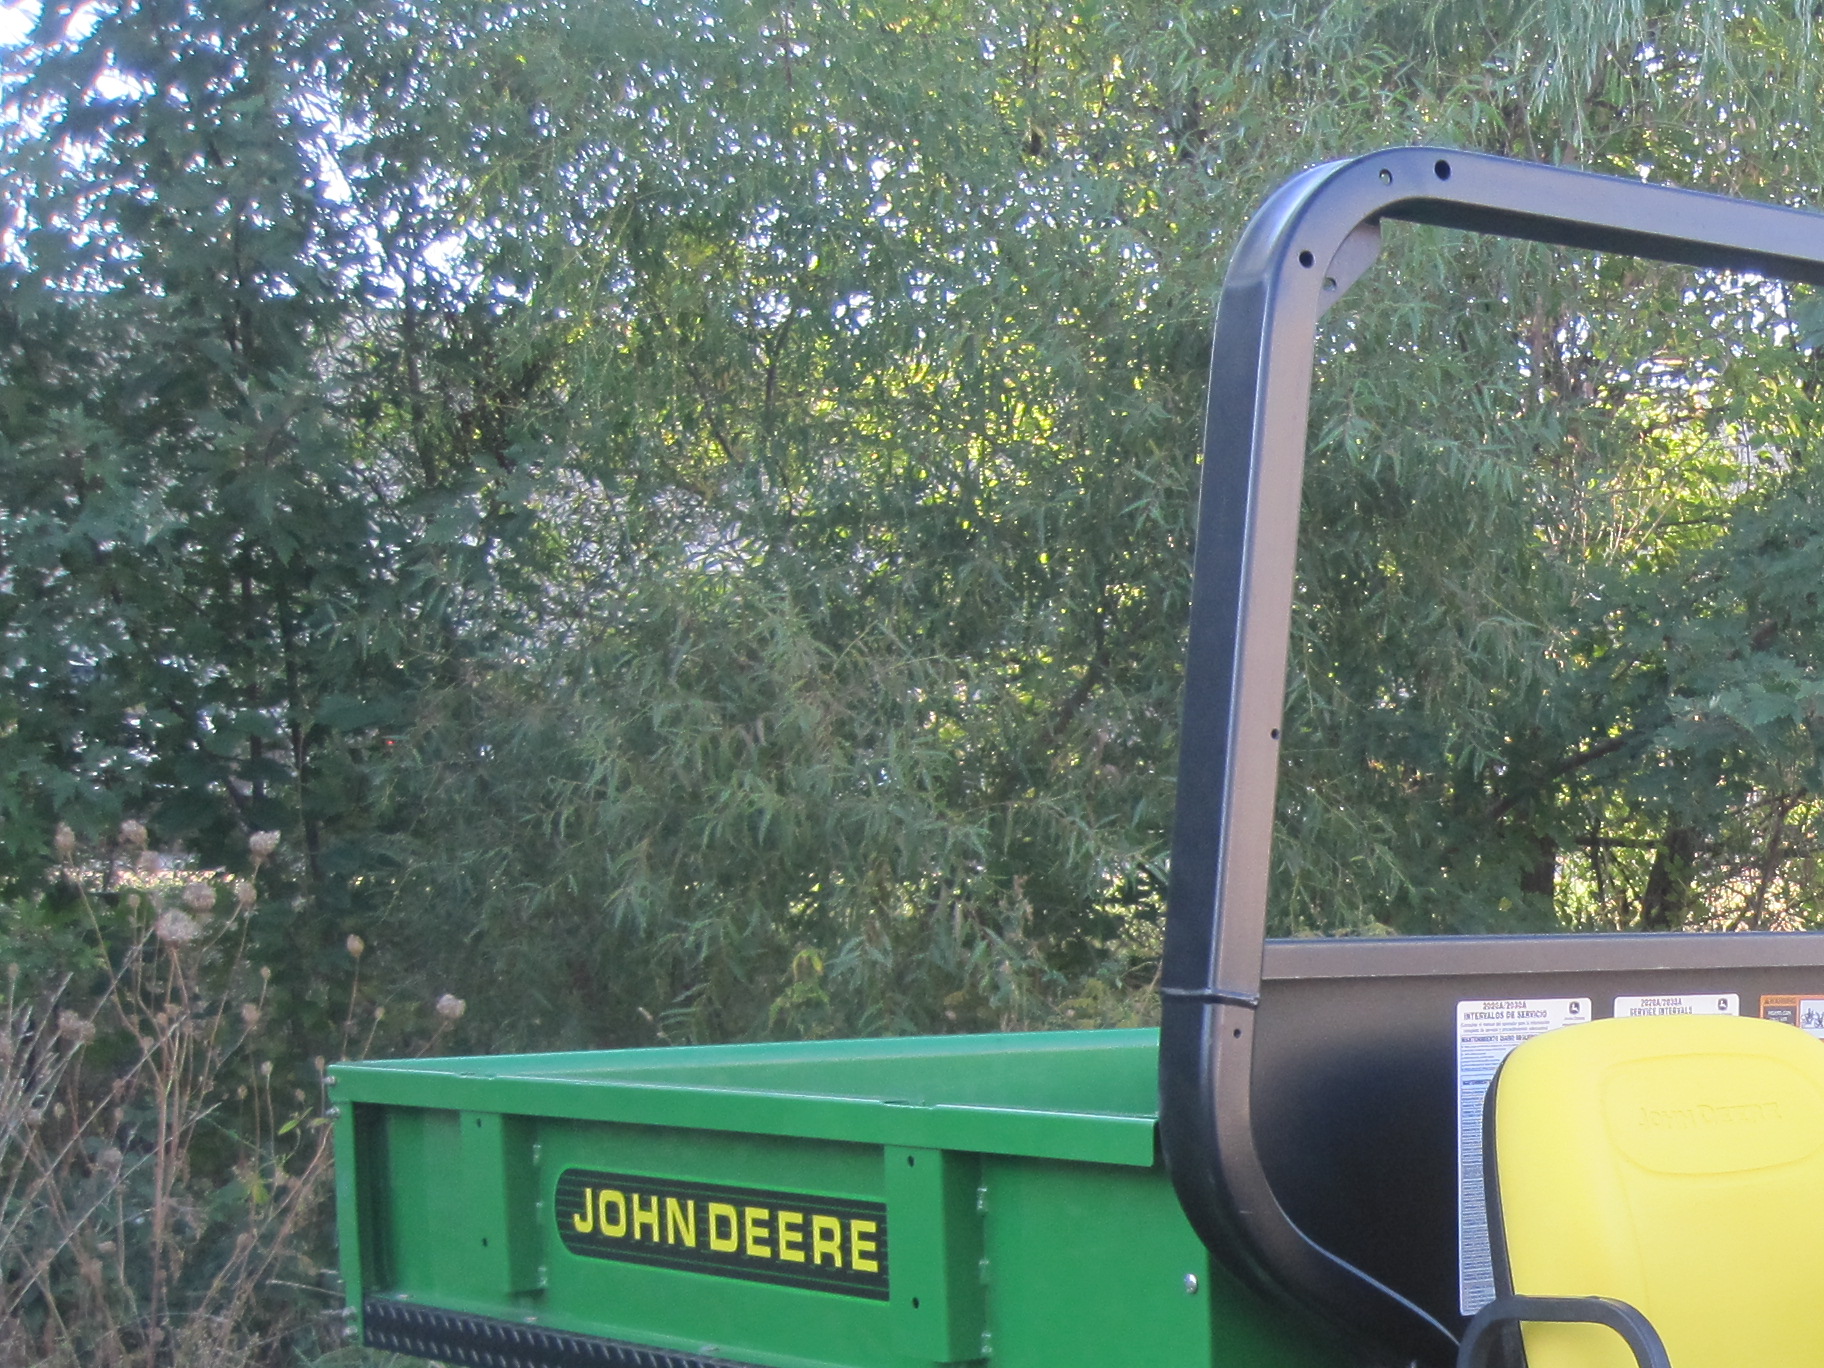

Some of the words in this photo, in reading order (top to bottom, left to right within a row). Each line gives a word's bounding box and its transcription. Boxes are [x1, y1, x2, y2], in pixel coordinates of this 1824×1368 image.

[1463, 1011, 1504, 1020] INTERVALOS
[1506, 1011, 1515, 1019] DE
[1517, 1010, 1548, 1019] SERVICIO
[572, 1187, 697, 1248] JOHN
[708, 1201, 879, 1273] DEERE
